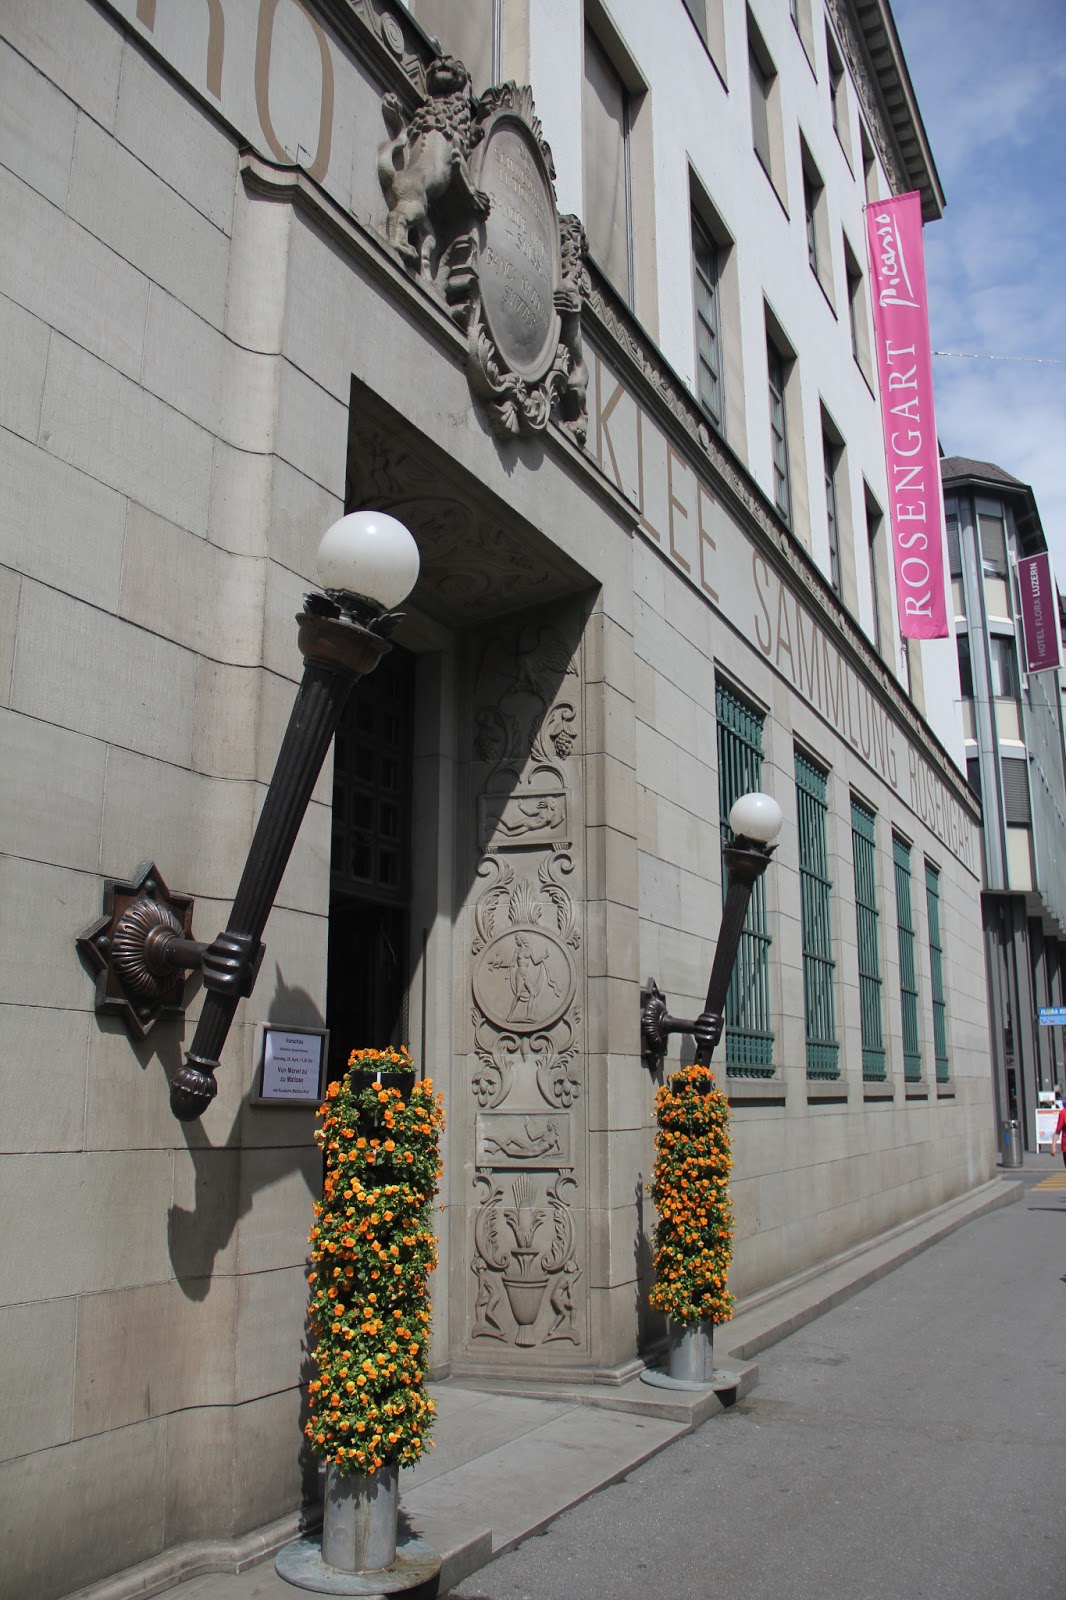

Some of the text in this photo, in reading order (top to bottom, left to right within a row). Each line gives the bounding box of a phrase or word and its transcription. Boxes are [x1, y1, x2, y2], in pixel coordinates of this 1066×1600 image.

[595, 350, 976, 873] KLEE SAMMLUNG ROSENGART
[886, 340, 932, 618] ROSENGART
[1030, 562, 1046, 657] HOTEL FLORA LUZERN
